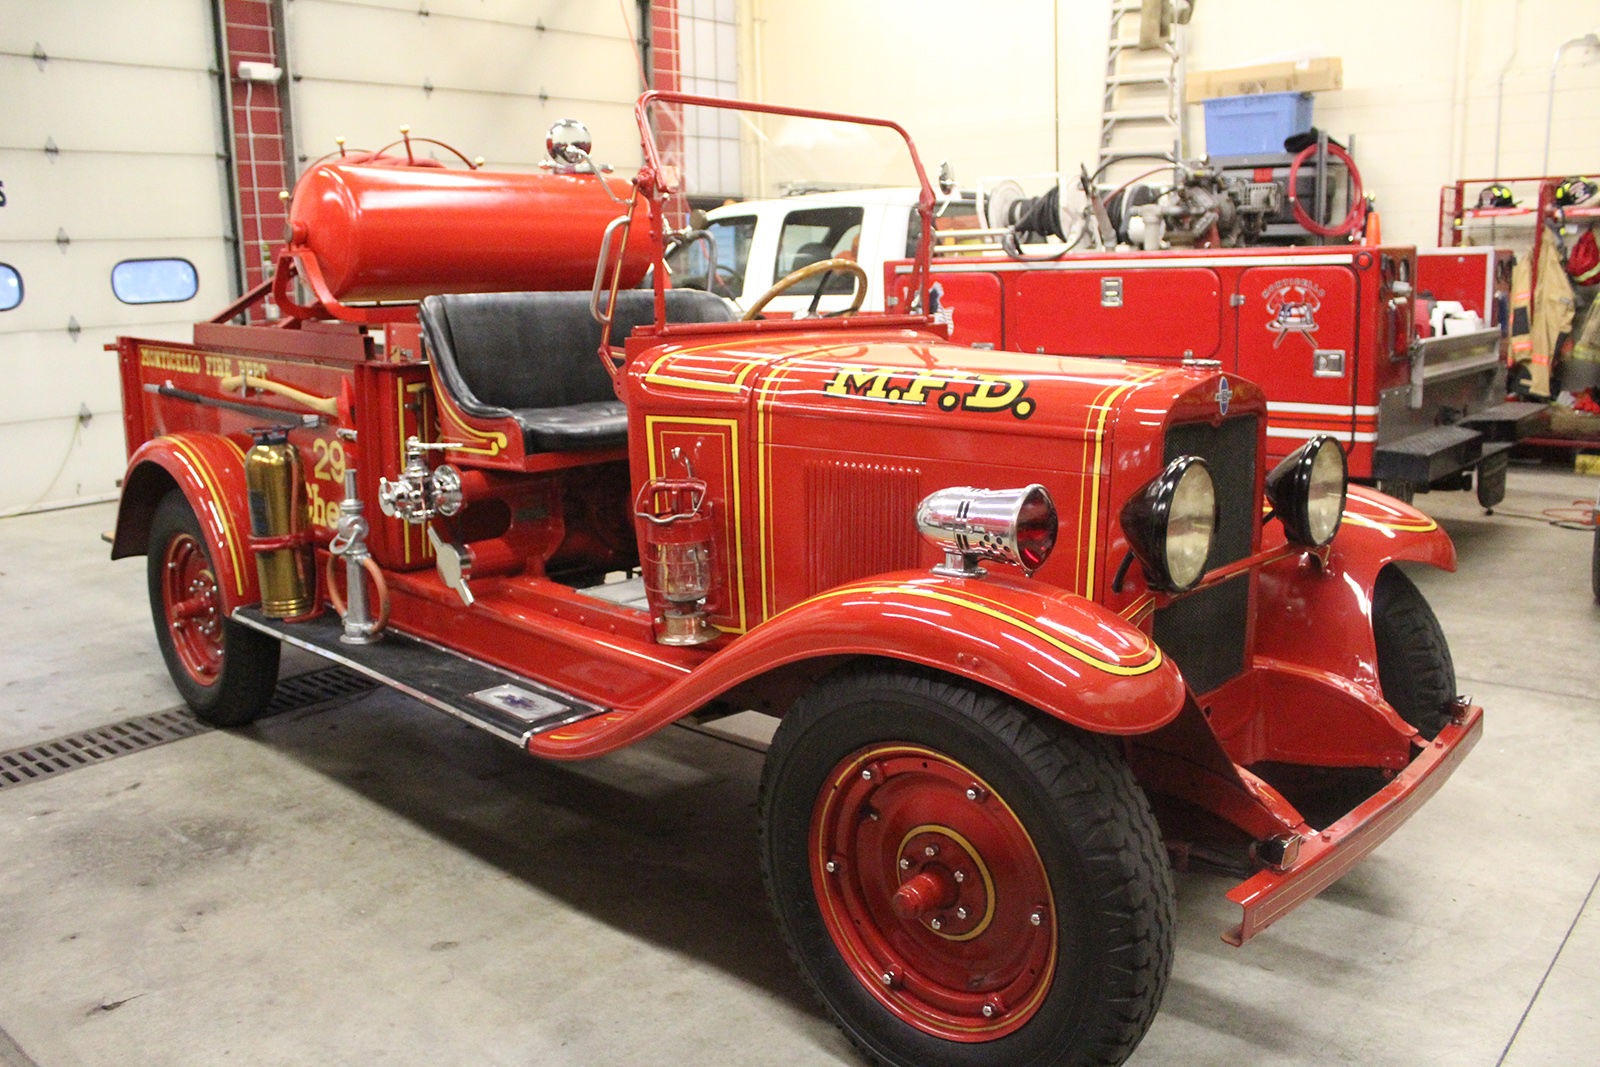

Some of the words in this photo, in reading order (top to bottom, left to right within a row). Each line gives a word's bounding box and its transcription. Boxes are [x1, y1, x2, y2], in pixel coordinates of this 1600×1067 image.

[1262, 278, 1326, 298] MONTICELLO
[140, 348, 200, 374] MONTICELLO
[205, 355, 232, 378] FIRE
[823, 366, 1036, 420] M.F.D.
[312, 438, 346, 484] 29
